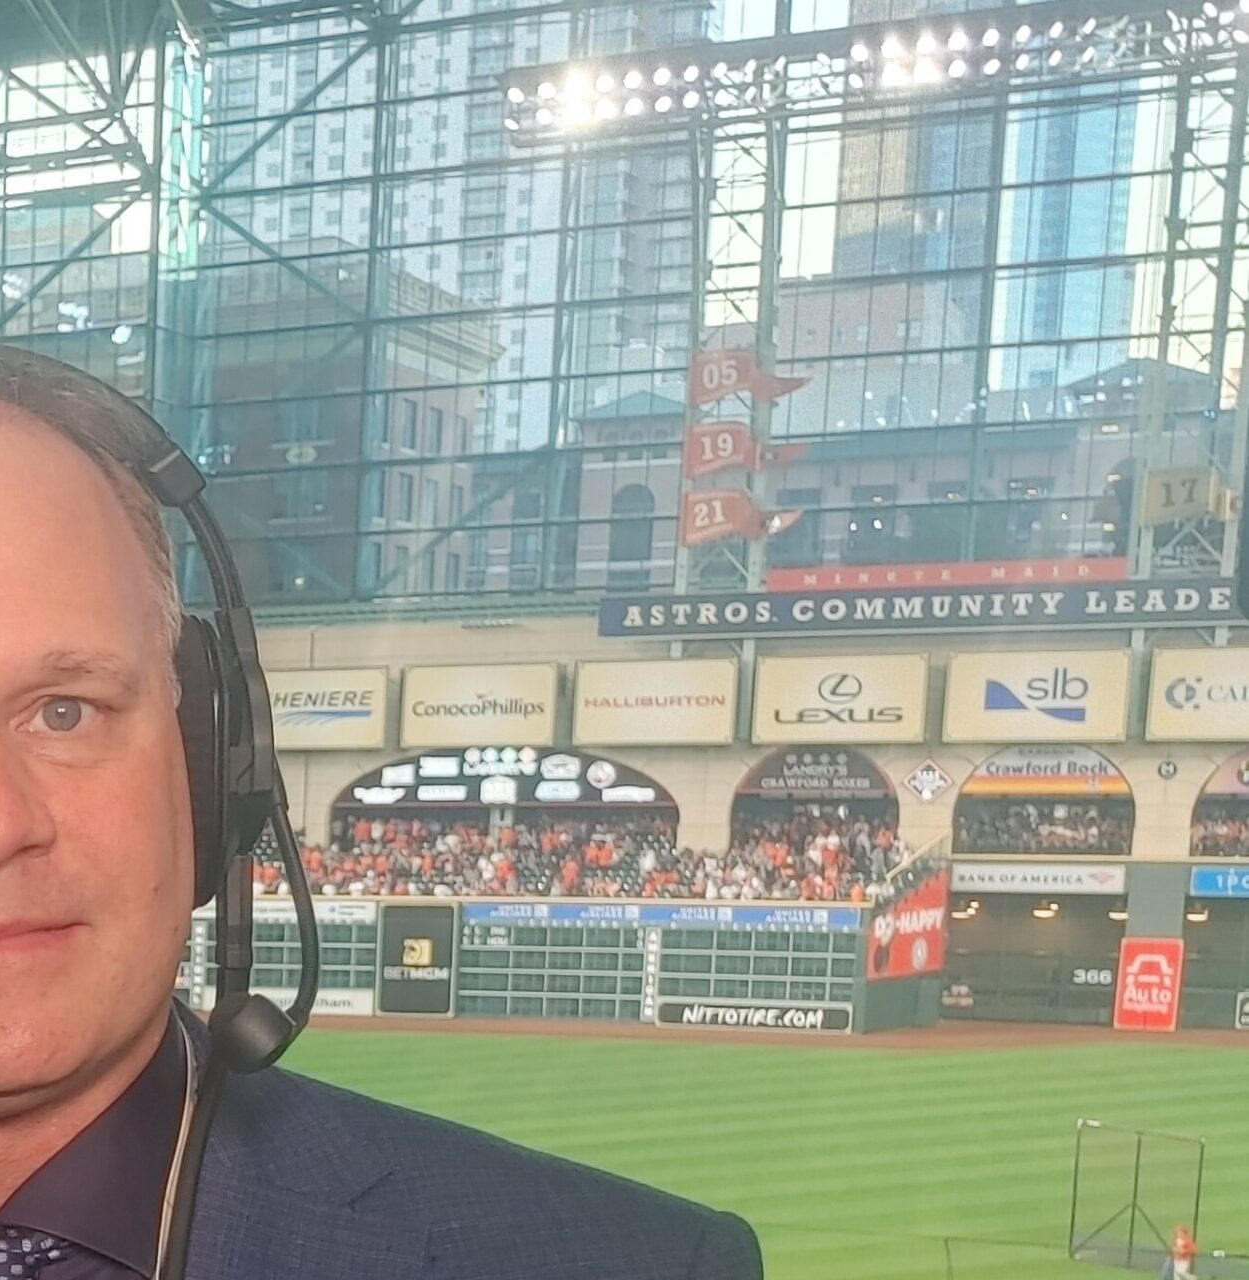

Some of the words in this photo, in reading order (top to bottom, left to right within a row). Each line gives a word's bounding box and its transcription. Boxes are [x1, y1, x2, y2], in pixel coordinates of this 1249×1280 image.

[702, 359, 738, 389] 05
[701, 432, 734, 461] 19
[1160, 478, 1199, 508] 17
[694, 500, 725, 528] 21
[803, 568, 951, 585] MINUTE
[991, 564, 1092, 580] MAID
[791, 590, 1067, 622] COMMUNITY
[1027, 667, 1089, 701] slb
[273, 690, 374, 709] HENIERE
[412, 698, 546, 718] ConocoPhillips
[584, 694, 726, 708] HALLIBURTON
[774, 707, 903, 724] LEXUS
[986, 761, 1060, 775] Crawford
[1068, 761, 1108, 774] Bock
[958, 874, 995, 883] BANK
[1000, 874, 1017, 883] OF
[1020, 874, 1083, 883] AMERICA
[1073, 969, 1113, 985] 366
[1123, 985, 1171, 1003] Auto
[682, 1004, 824, 1031] NITTOTIRE.COM
